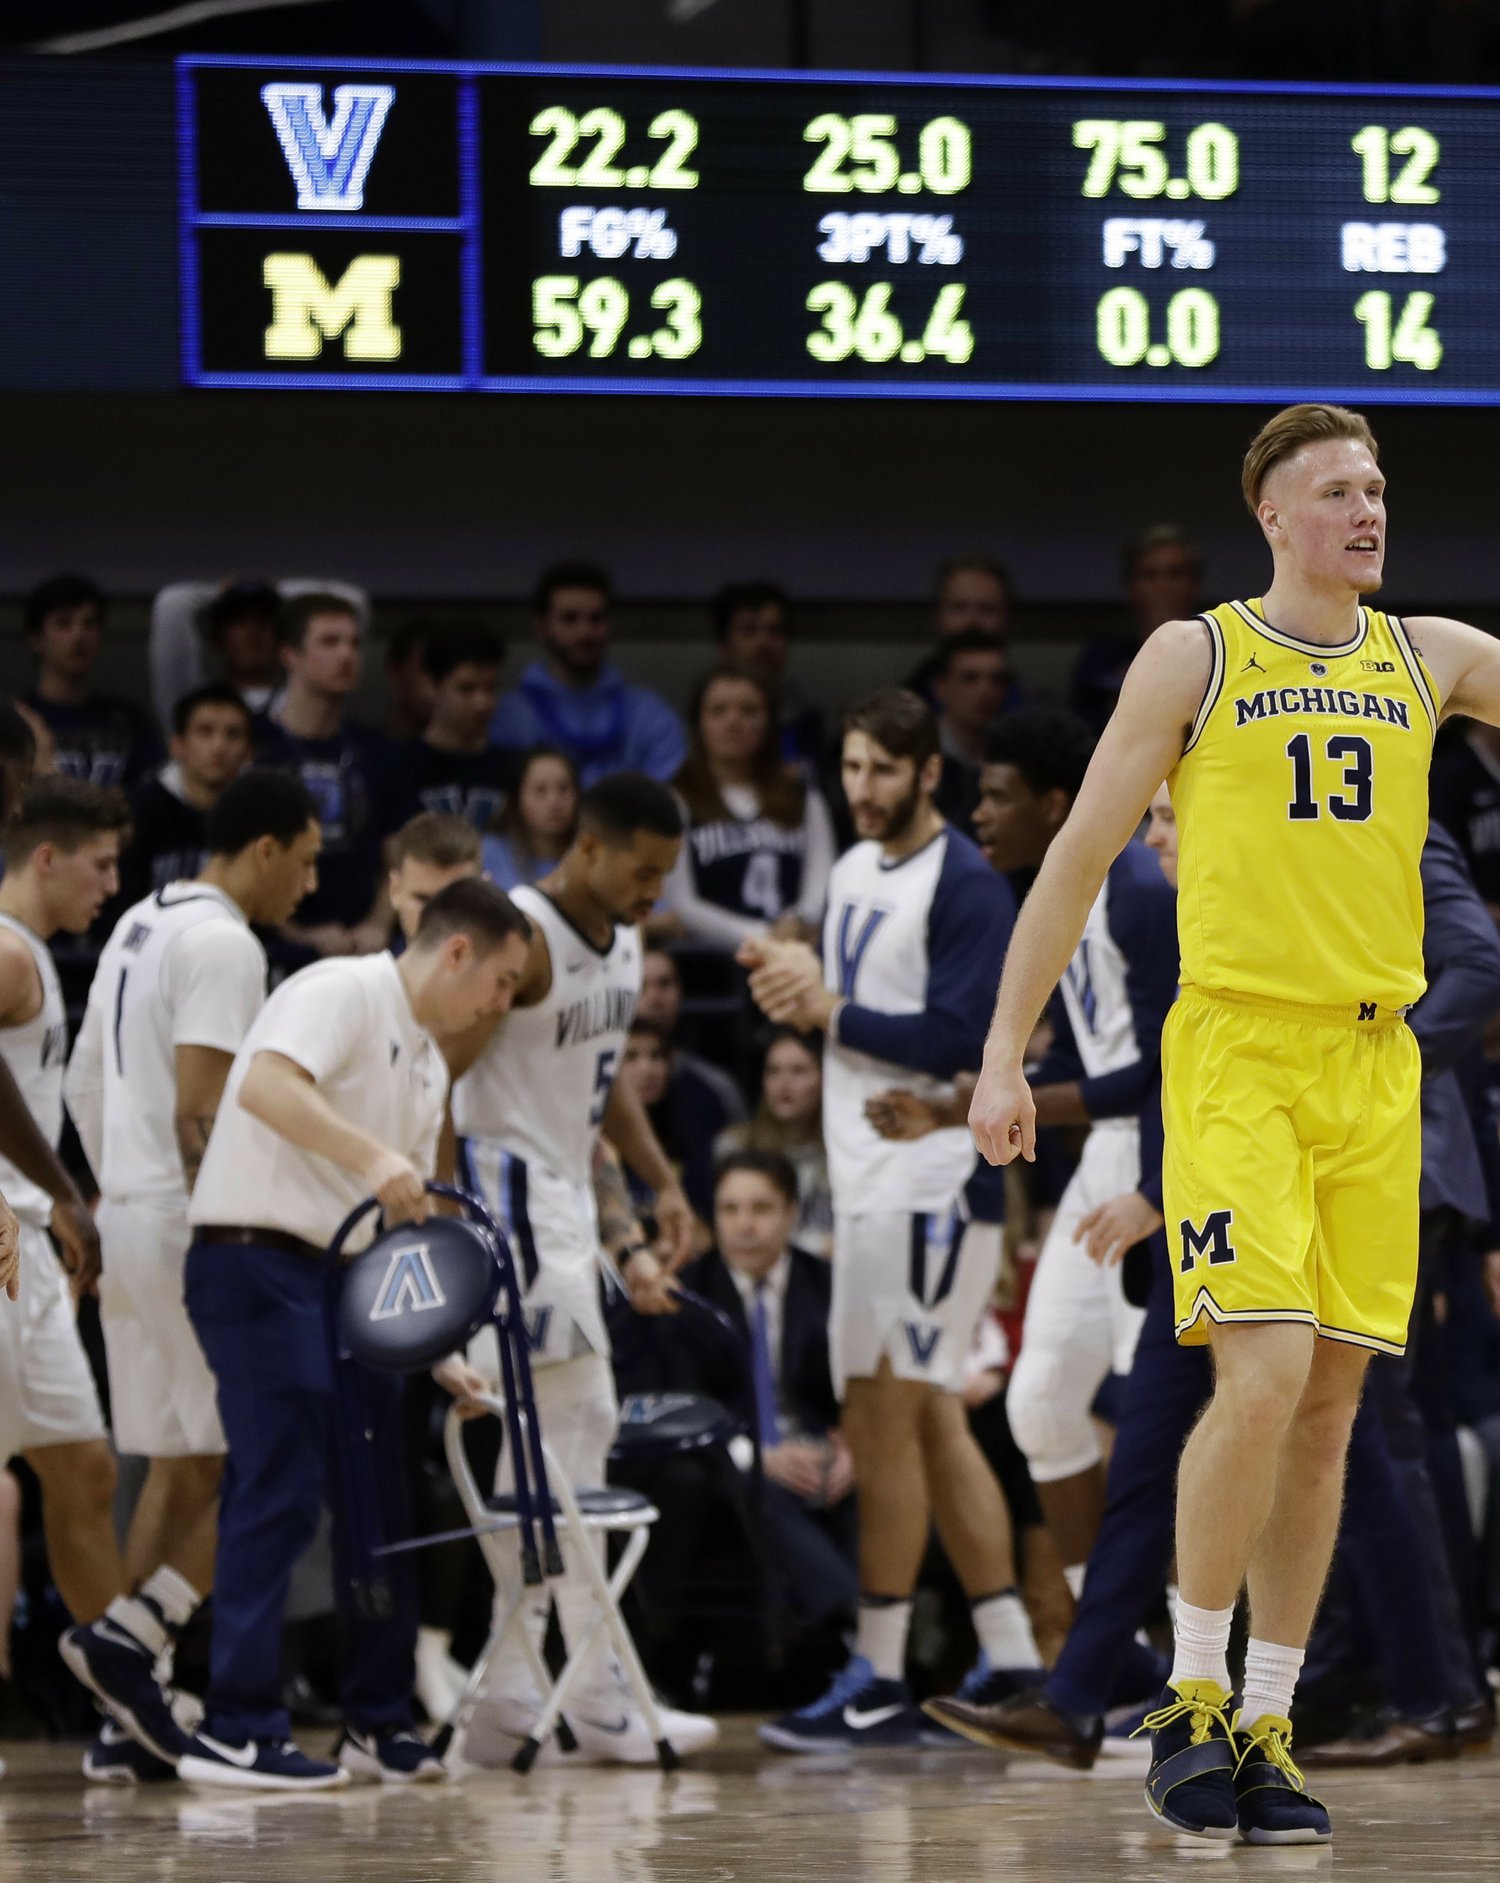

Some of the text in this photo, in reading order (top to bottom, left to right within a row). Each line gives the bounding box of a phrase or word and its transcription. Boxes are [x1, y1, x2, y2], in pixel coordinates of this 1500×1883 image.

[260, 82, 397, 211] V
[528, 105, 700, 191] 22.2
[802, 112, 972, 196] 25.0
[1071, 118, 1240, 202] 75.0
[1350, 124, 1441, 206] 12
[559, 205, 679, 261] FG%
[817, 210, 964, 266] 3PT%
[1101, 216, 1216, 271] FT%
[1339, 220, 1448, 275] REB
[262, 253, 402, 362] M
[531, 274, 704, 361] 59.3
[805, 280, 976, 365] 36.4
[1095, 285, 1221, 369] 0.0
[1353, 289, 1444, 372] 14
[1234, 687, 1412, 730] MICHIGAN
[1285, 733, 1373, 822] 13
[1357, 1002, 1377, 1021] M
[589, 1050, 616, 1127] 5
[1179, 1208, 1237, 1274] M
[905, 1322, 942, 1368] V
